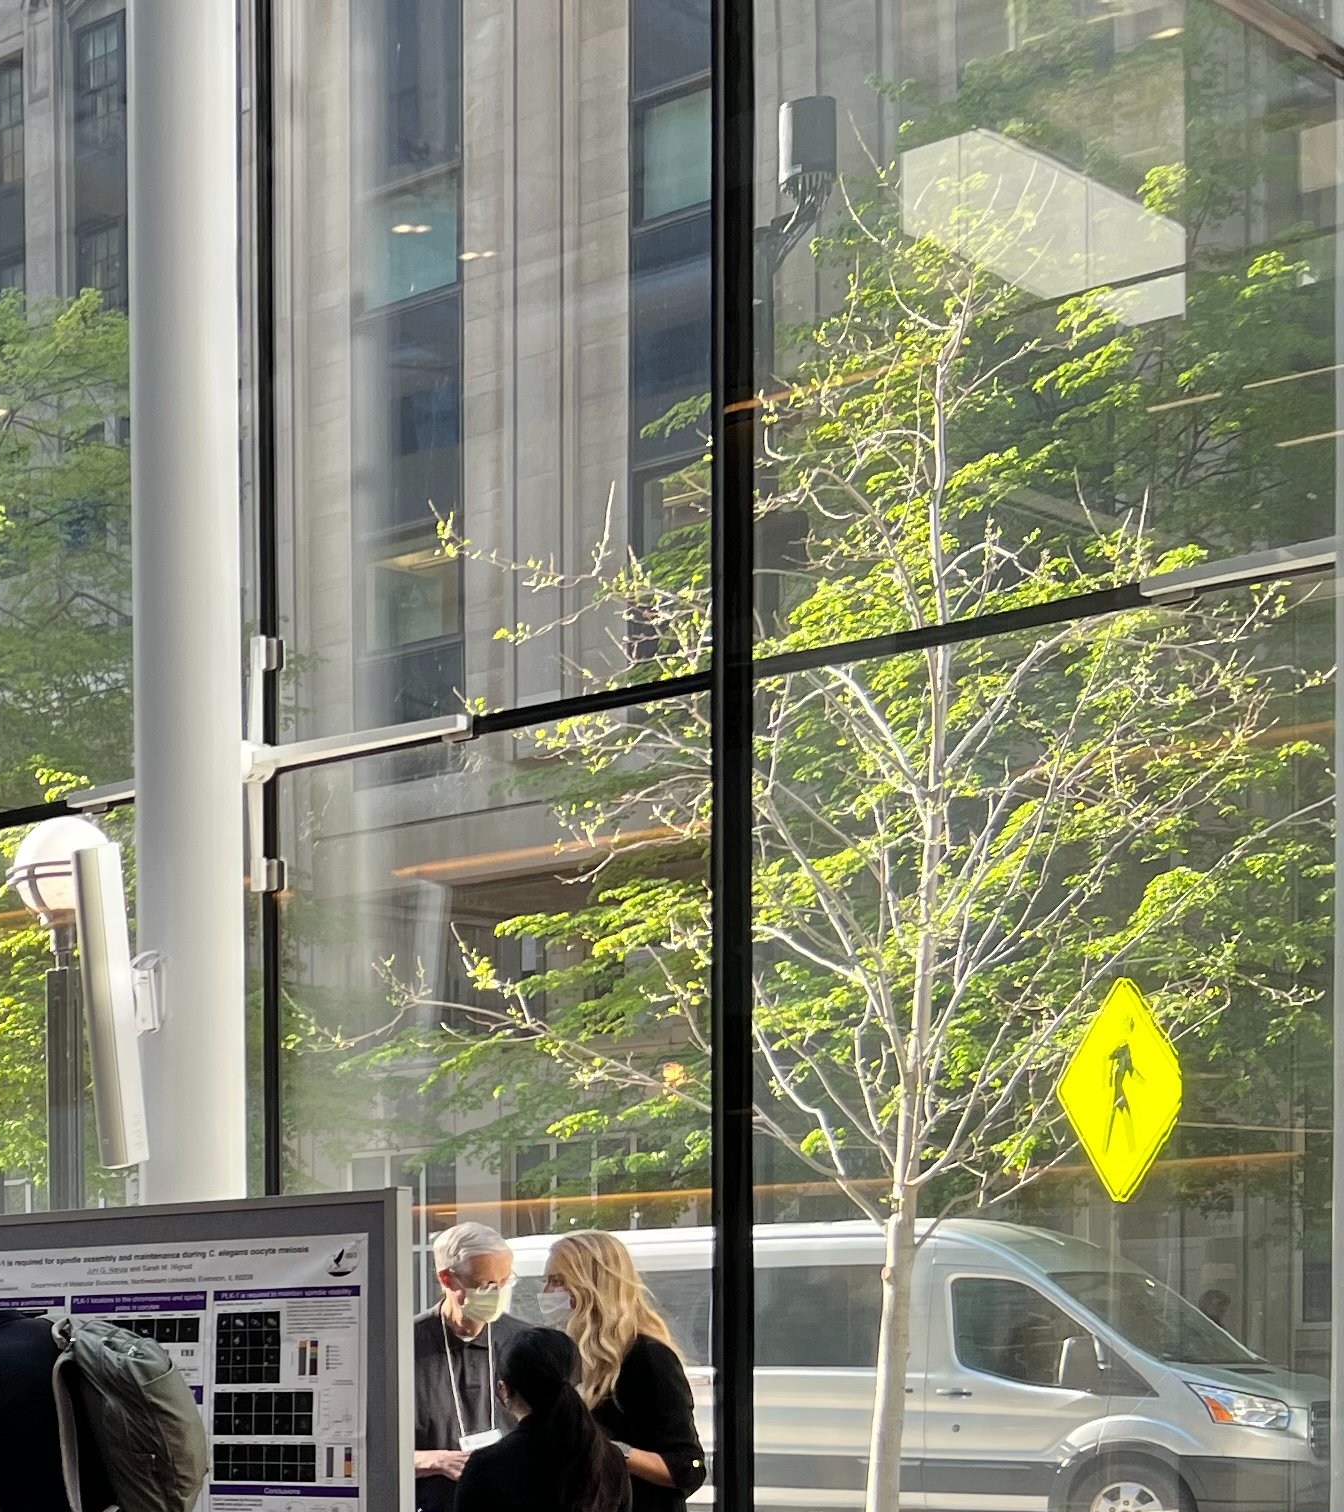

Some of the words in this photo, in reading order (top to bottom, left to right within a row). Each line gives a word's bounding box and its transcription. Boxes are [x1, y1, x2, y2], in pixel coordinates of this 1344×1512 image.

[15, 1258, 43, 1268] required
[45, 1257, 55, 1265] for
[56, 1256, 81, 1268] spindle
[83, 1255, 116, 1265] assembly
[119, 1253, 132, 1262] and
[134, 1252, 180, 1261] maintenance
[182, 1250, 206, 1260] during
[218, 1247, 248, 1258] elegans
[278, 1245, 310, 1254] meiosis
